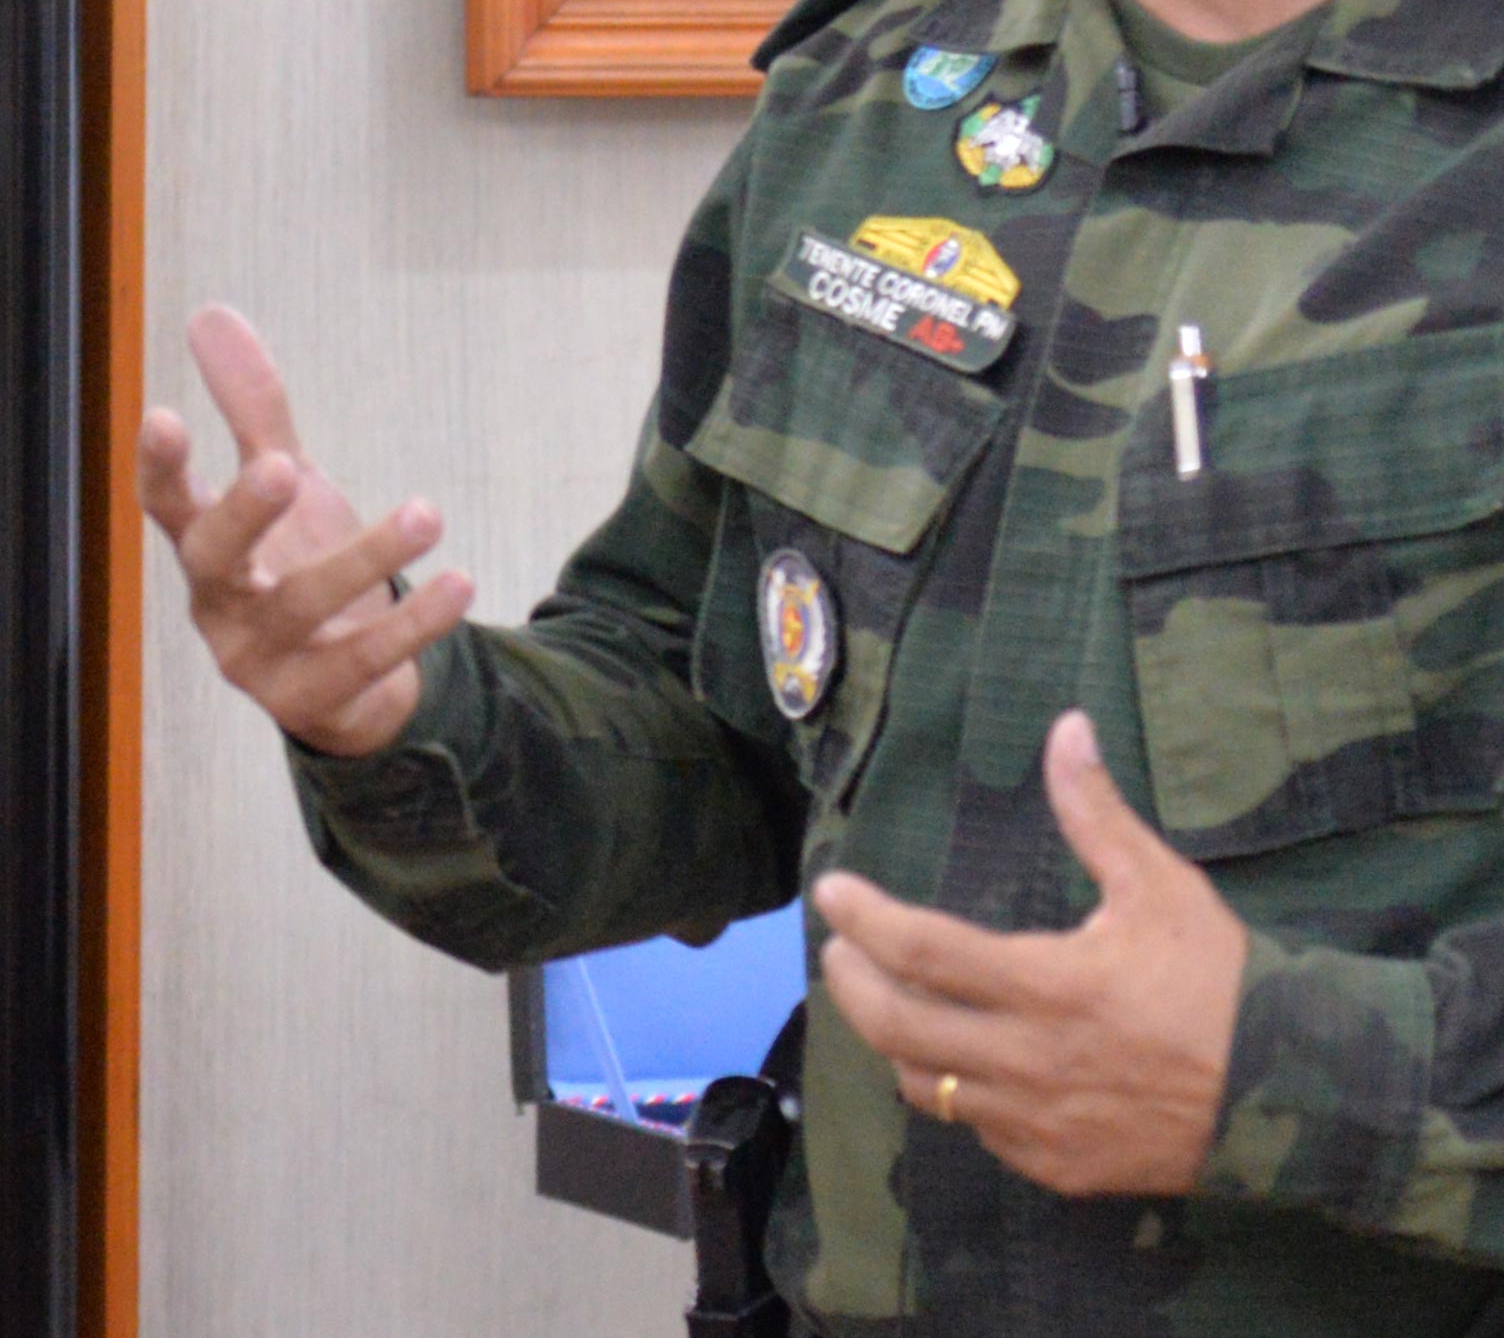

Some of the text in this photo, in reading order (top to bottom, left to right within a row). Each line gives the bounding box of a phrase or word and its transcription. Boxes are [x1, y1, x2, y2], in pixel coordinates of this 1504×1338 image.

[798, 235, 1008, 341] TENENTE CORONEL PM
[808, 270, 906, 331] COSME
